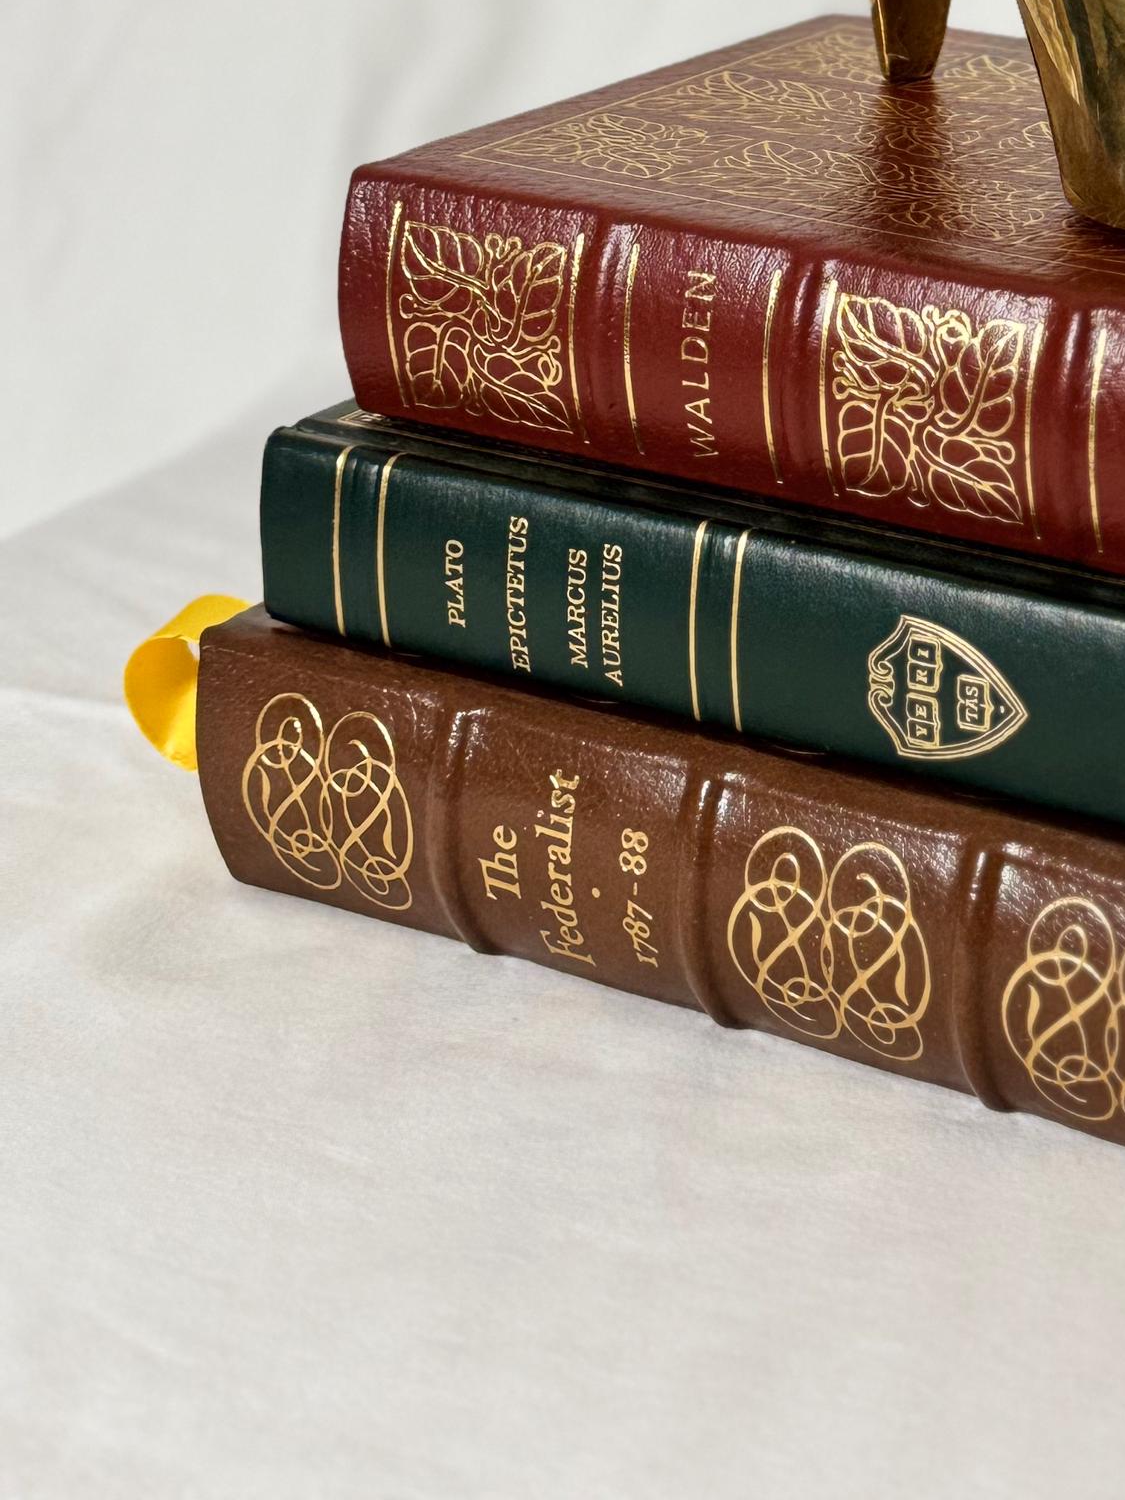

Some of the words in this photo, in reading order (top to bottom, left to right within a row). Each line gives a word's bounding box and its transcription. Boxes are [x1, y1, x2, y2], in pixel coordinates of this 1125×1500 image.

[681, 270, 720, 458] WALDEN
[445, 539, 467, 629] PLATO
[506, 515, 532, 673] EPICTETUS
[566, 548, 589, 669] MARCUS
[601, 543, 624, 688] AURELIUS
[964, 685, 980, 723] TAS
[477, 824, 522, 901] The
[534, 768, 598, 968] Federalist
